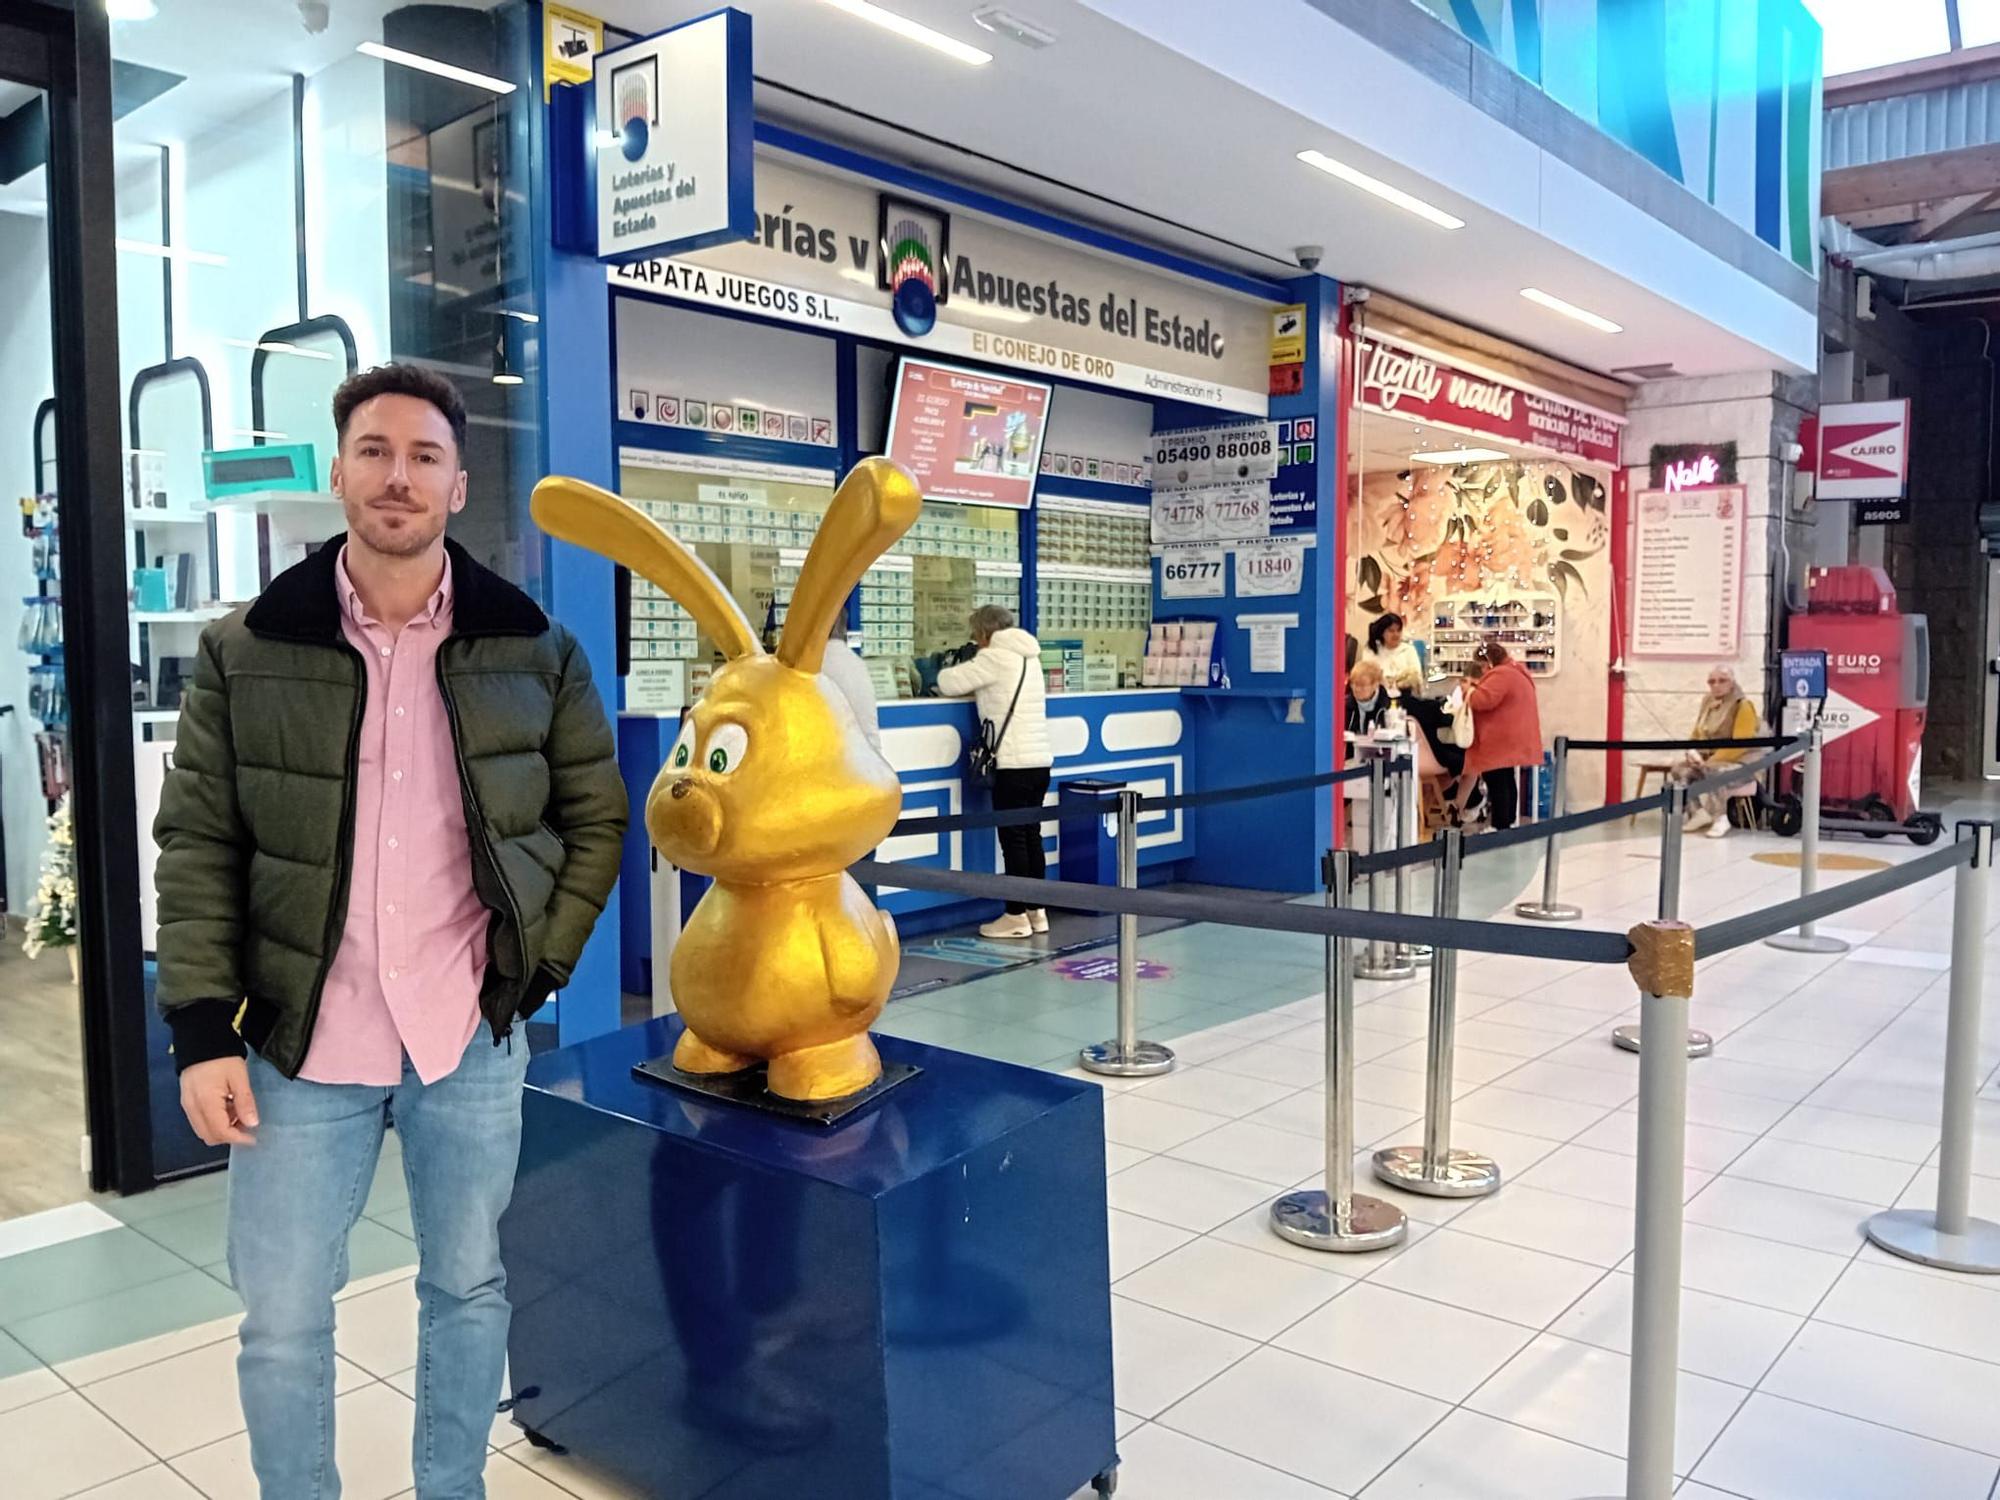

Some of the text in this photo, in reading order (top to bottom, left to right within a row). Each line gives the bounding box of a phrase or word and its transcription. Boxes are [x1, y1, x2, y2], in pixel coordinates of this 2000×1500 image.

[667, 162, 675, 182] y
[613, 176, 695, 216] Apuestas del
[613, 212, 656, 238] Estado
[617, 259, 840, 323] ZAPATA JUEGOS S.L.
[952, 255, 1091, 326] Apuestas
[1099, 293, 1136, 338] del
[1145, 307, 1225, 359] Estado
[993, 337, 1056, 367] CONEJO
[1061, 351, 1080, 372] DE
[1085, 356, 1115, 379] ORO
[1157, 440, 1271, 465] 05490 88008
[1850, 445, 1896, 456] CAJERO
[1163, 501, 1260, 522] 74778 77768
[1864, 510, 1901, 521] aseos
[1162, 536, 1299, 550] PREMIOS PREMIOS
[1165, 558, 1293, 580] 66777 11840
[1783, 656, 1822, 668] ENTRADA
[1837, 654, 1881, 667] EURO
[1820, 713, 1849, 724] URO
